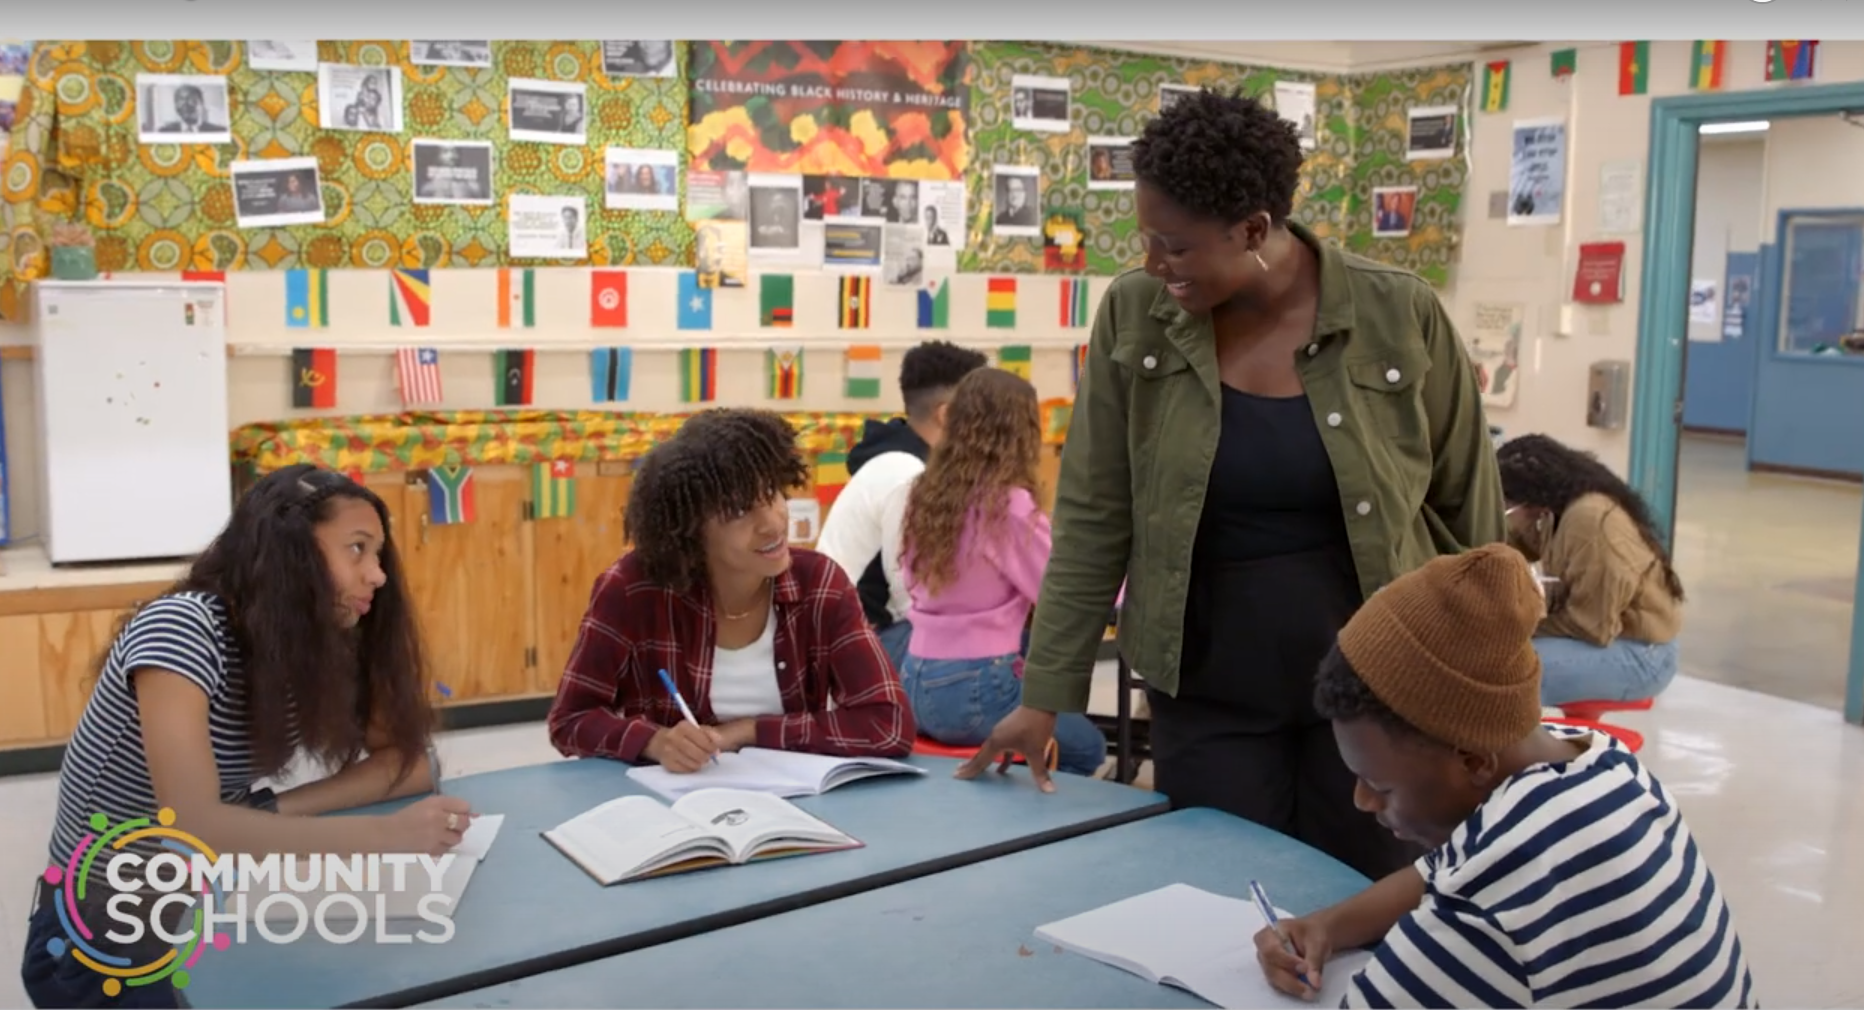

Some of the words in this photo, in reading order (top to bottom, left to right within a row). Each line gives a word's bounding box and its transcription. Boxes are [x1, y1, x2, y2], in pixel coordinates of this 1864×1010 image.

[695, 79, 786, 96] CELEBRATING
[791, 85, 833, 99] BLACK
[836, 89, 889, 103] HISTORY
[893, 93, 901, 103] &
[905, 94, 962, 108] HERITAGE
